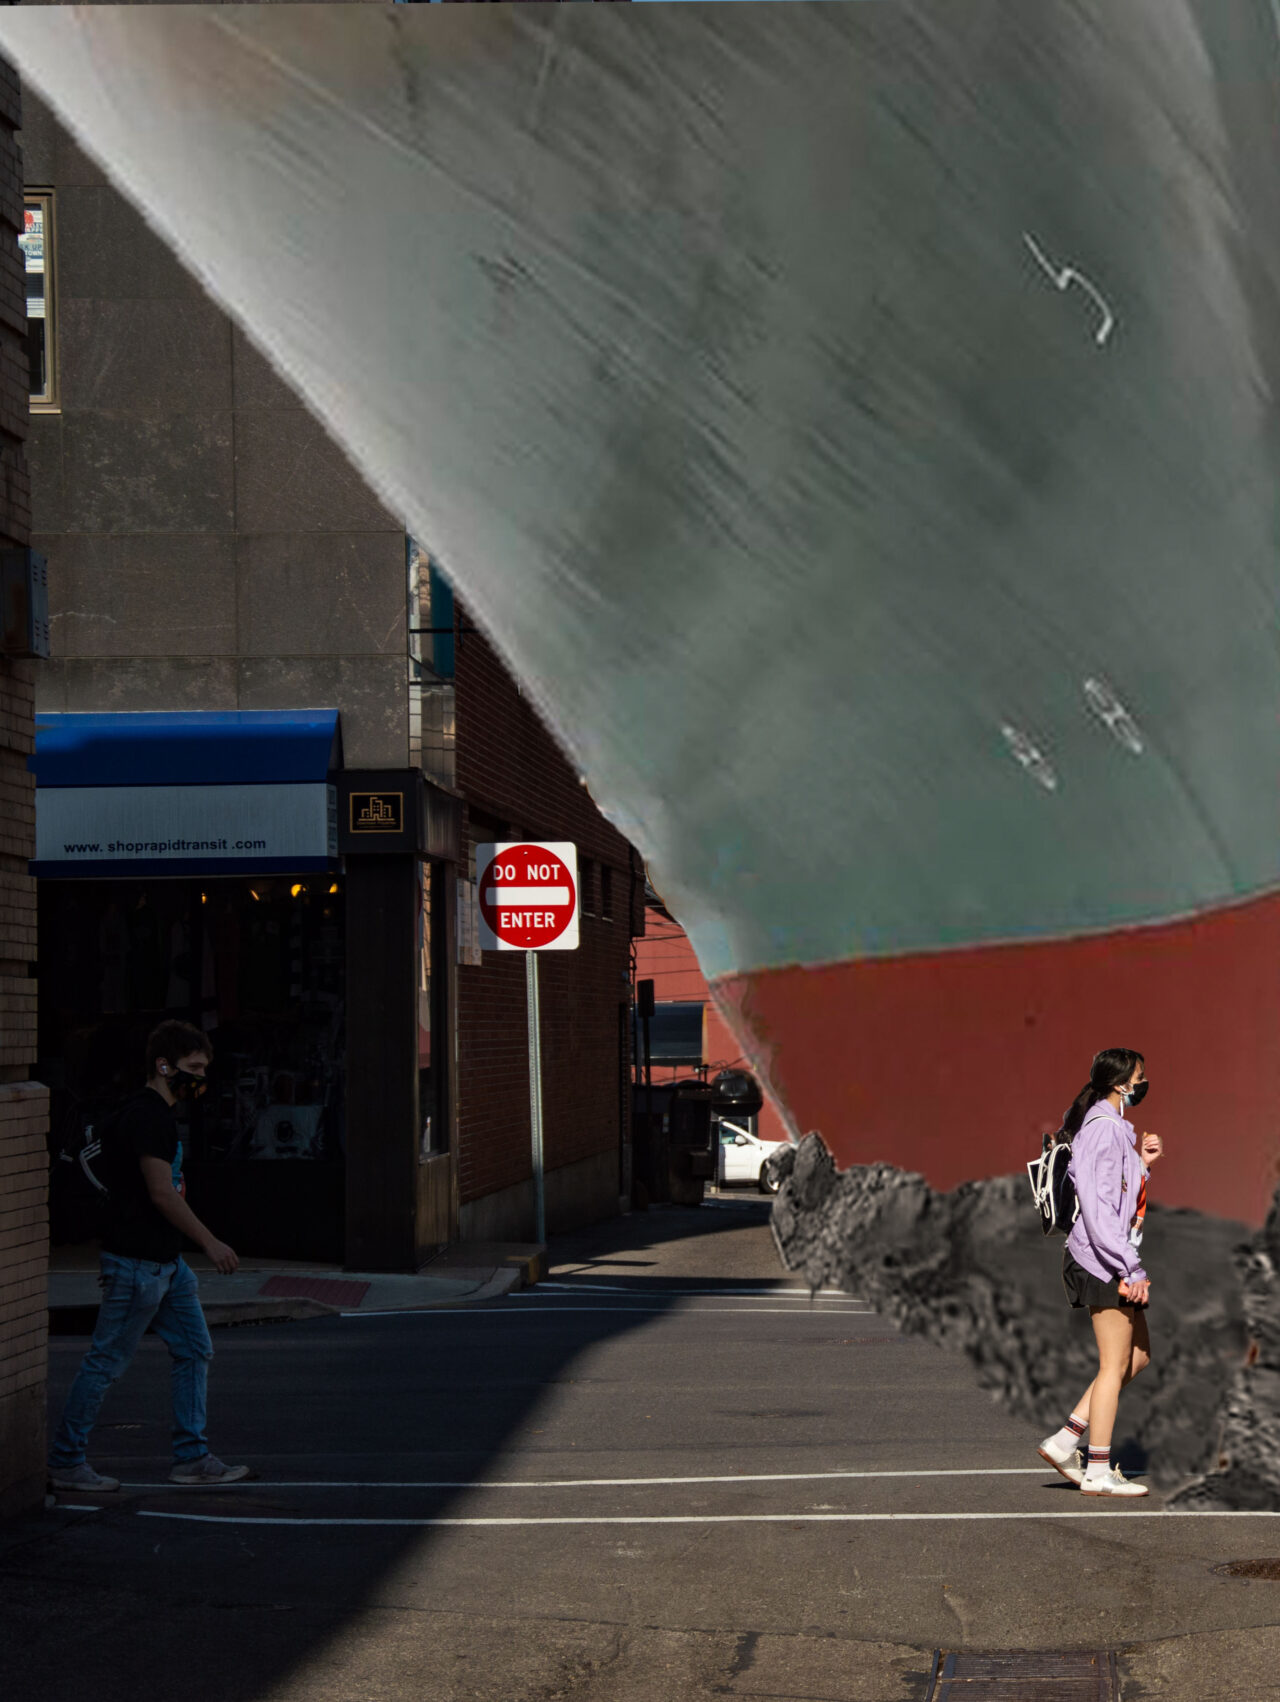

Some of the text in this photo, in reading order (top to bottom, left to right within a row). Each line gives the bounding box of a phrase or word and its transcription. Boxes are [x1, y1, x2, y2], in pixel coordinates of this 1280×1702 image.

[107, 838, 228, 854] shoprapidtransit
[493, 864, 561, 880] DO NOT
[500, 912, 556, 928] ENTER
